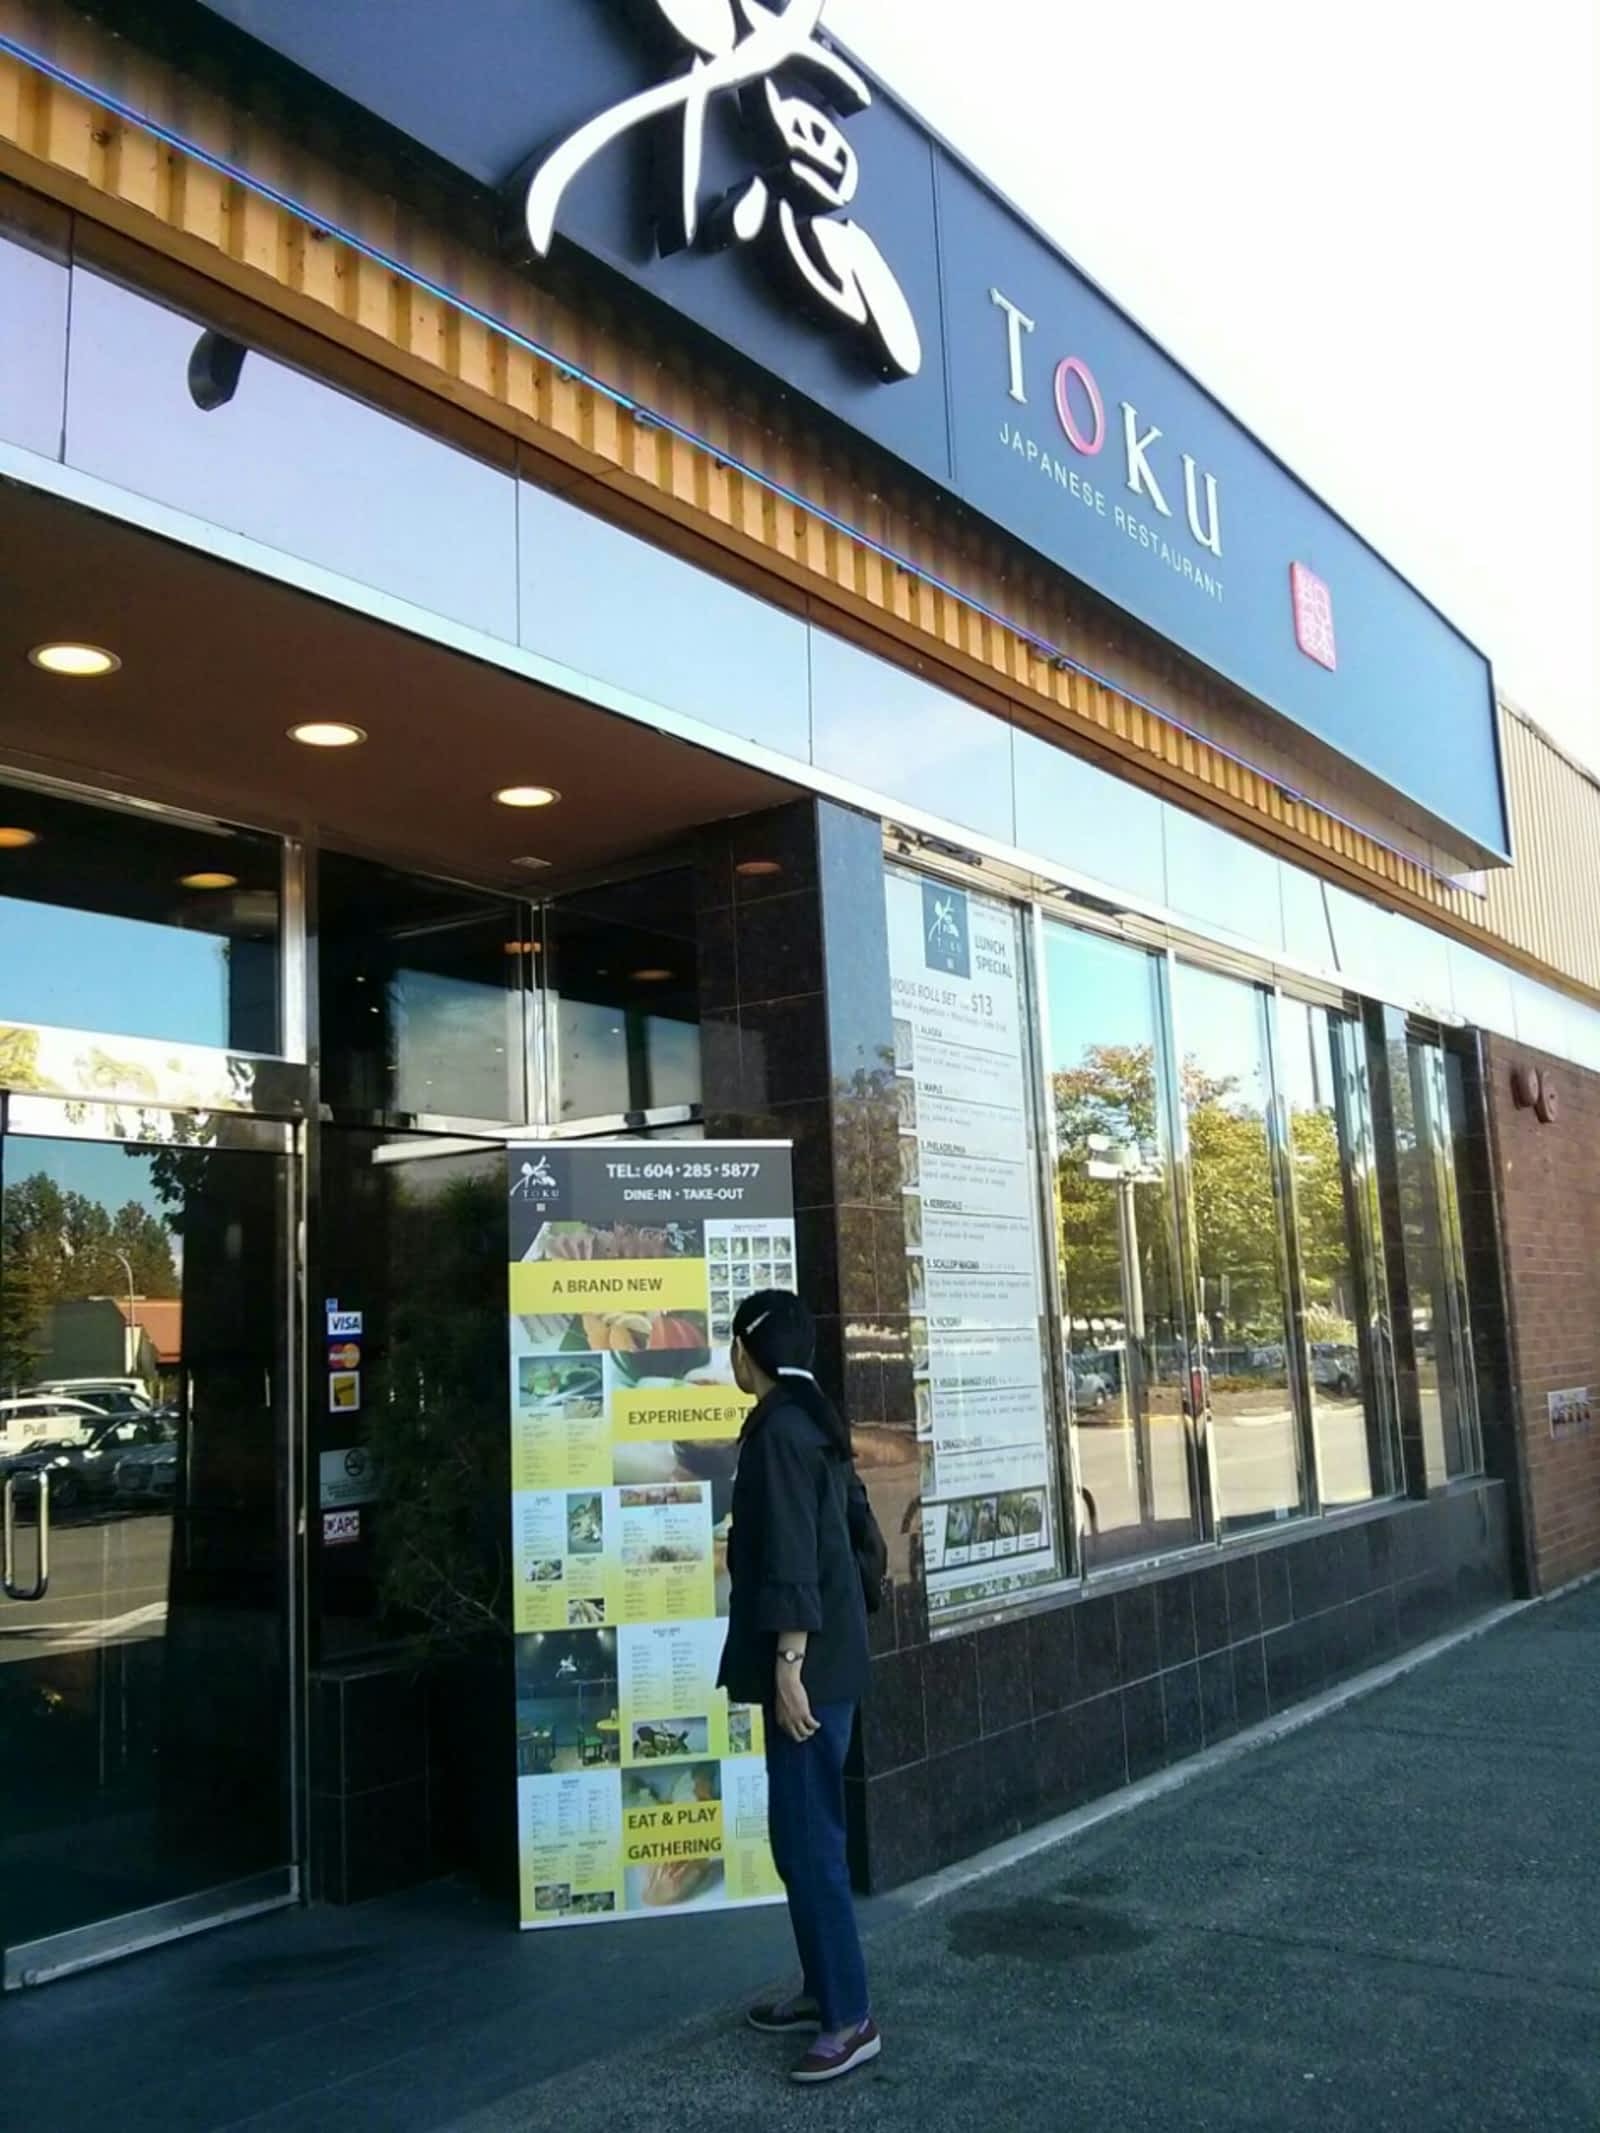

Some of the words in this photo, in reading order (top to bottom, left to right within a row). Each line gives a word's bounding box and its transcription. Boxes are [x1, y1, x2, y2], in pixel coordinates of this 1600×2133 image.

[989, 287, 1222, 557] TOKU
[999, 422, 1105, 517] JAPANESE
[1114, 505, 1225, 602] RESTAURANT
[975, 935, 1006, 957] LUNCH
[975, 955, 1014, 979] SPECIAL
[971, 993, 993, 1017] $13
[606, 1162, 641, 1179] TEL:
[623, 1188, 672, 1202] DINE-IN
[682, 1187, 745, 1201] TAKE-OUT
[552, 1280, 563, 1293] A
[566, 1278, 624, 1293] BRAND
[627, 1277, 664, 1292] NEW
[332, 1317, 361, 1331] VISA
[23, 1423, 48, 1436] Pull
[628, 1811, 657, 1830] EAT
[661, 1810, 673, 1826] &
[678, 1807, 718, 1824] PLAY
[627, 1837, 722, 1861] GATHERING
